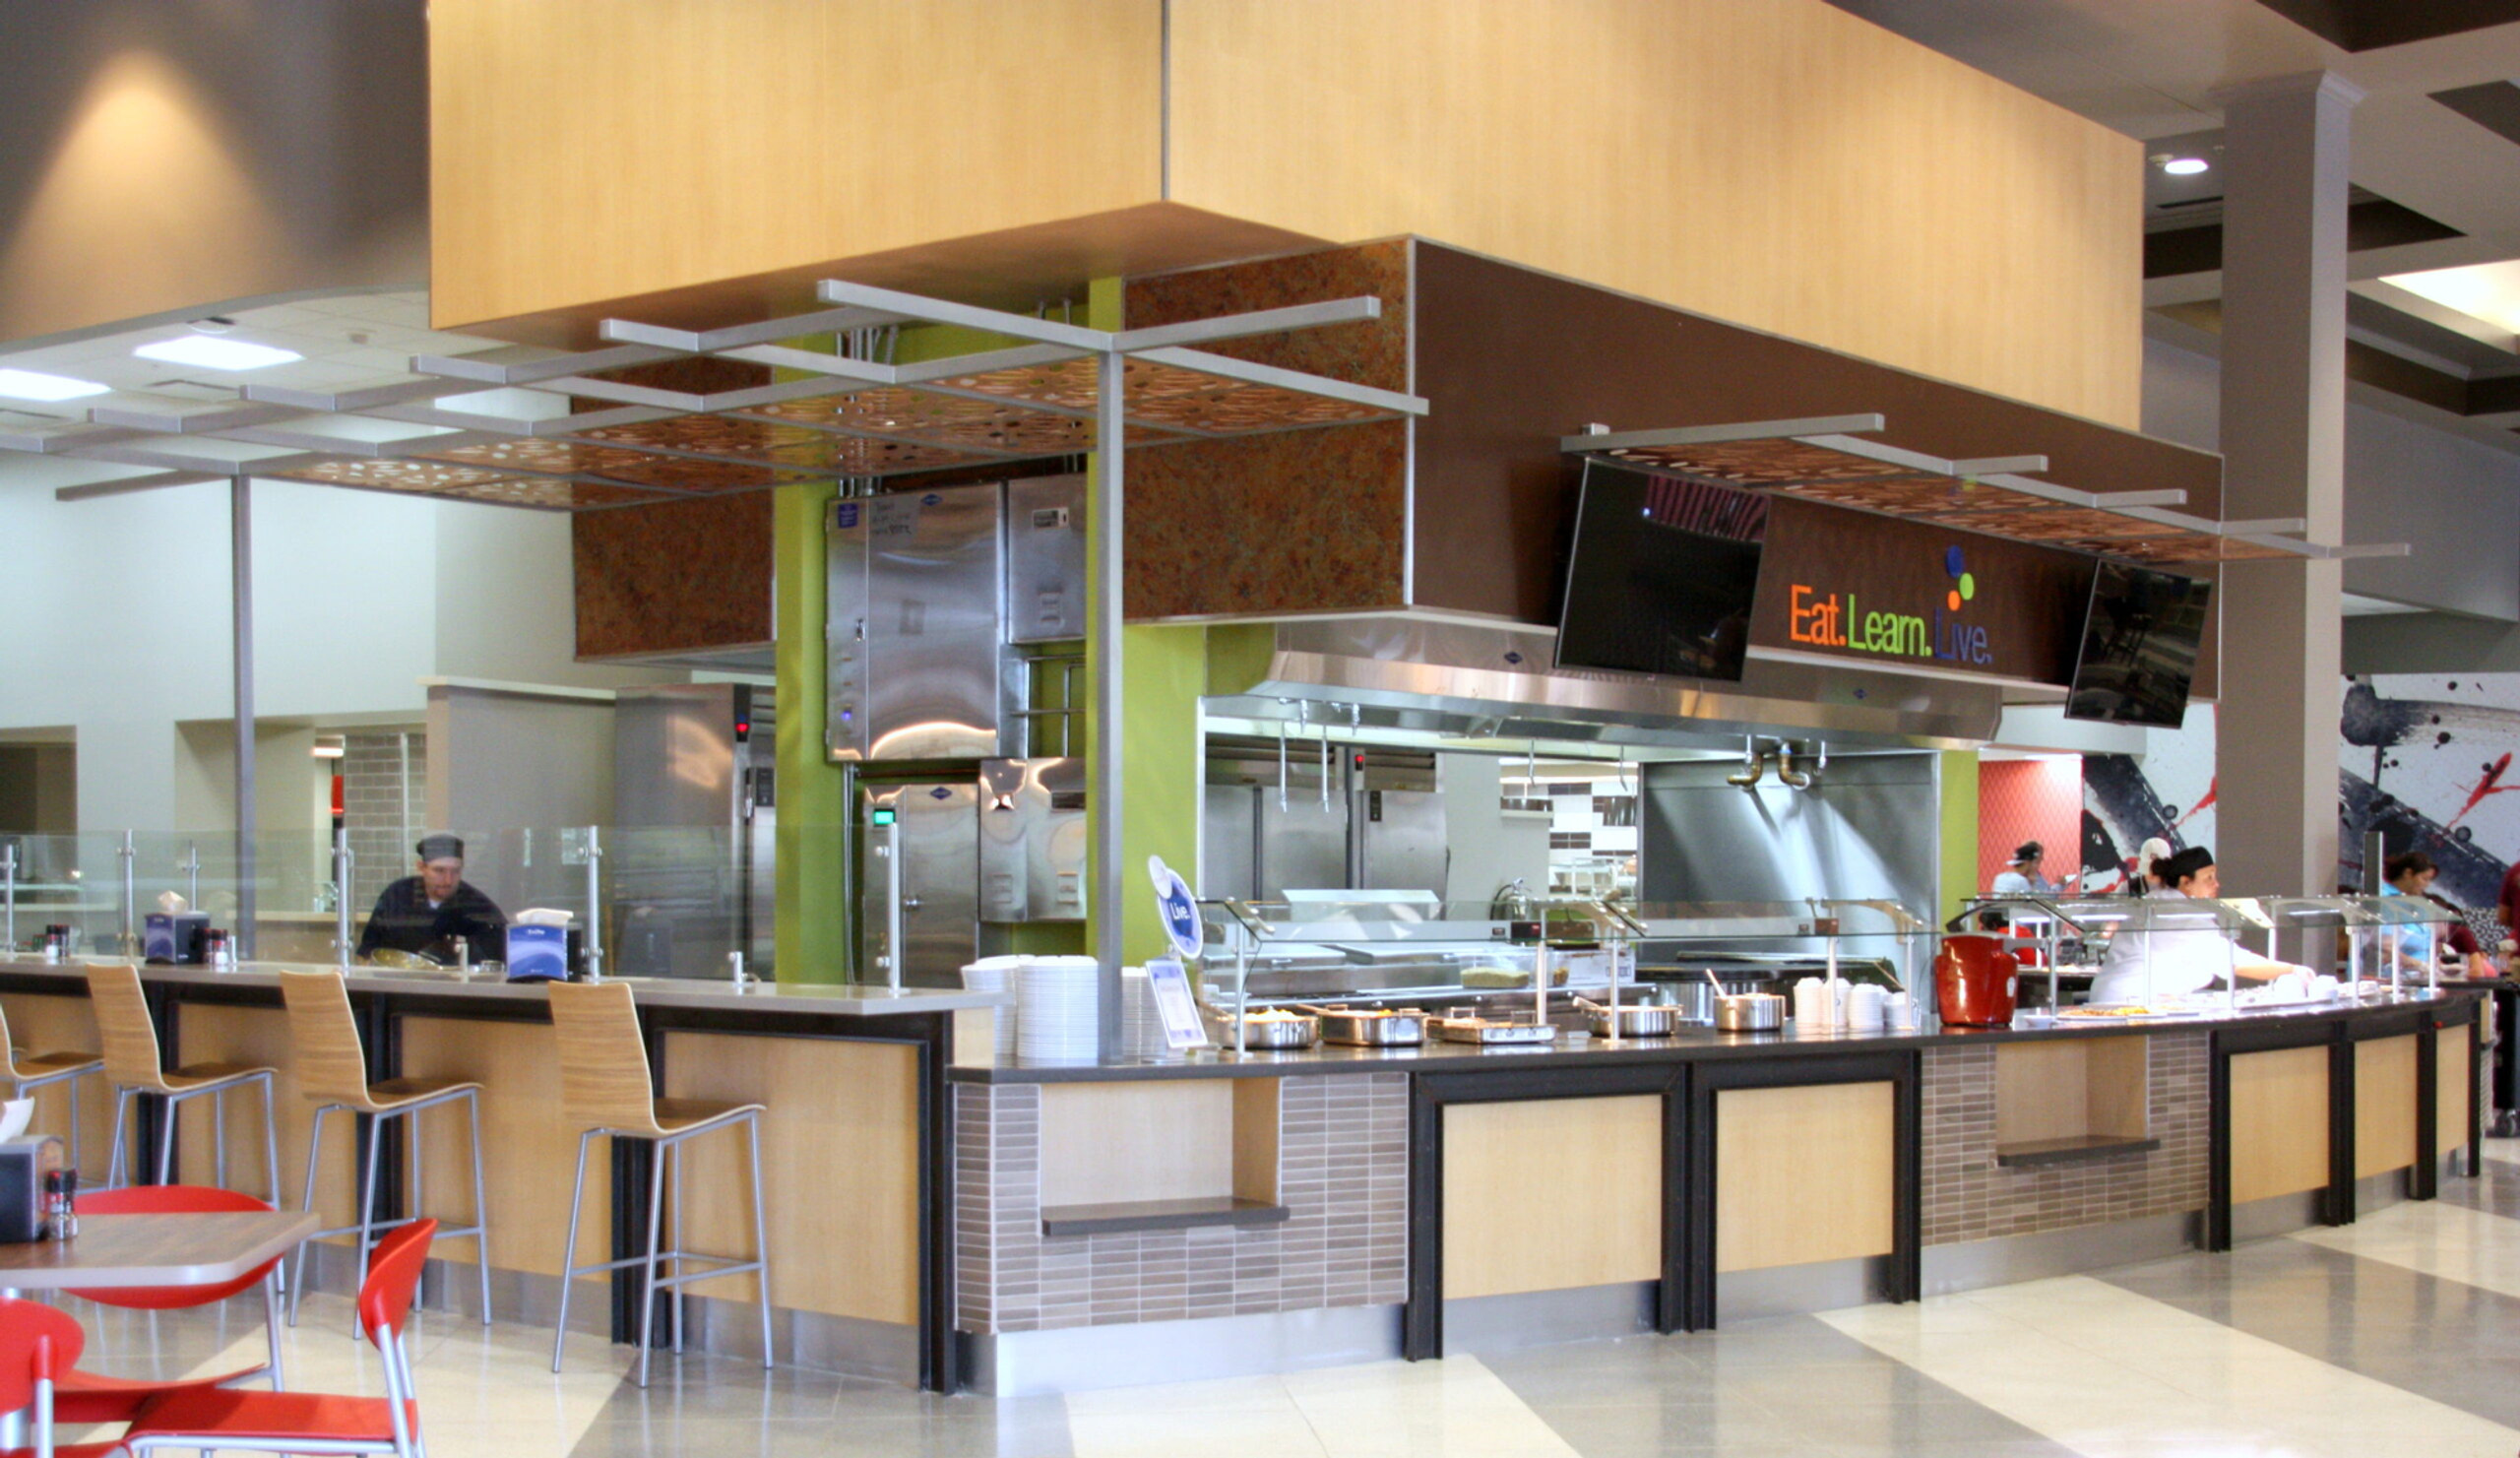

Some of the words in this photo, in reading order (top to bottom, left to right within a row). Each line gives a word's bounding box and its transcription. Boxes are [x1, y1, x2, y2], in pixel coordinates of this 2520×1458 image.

[1791, 584, 1847, 646] Eat.
[1848, 593, 1932, 657] Learn.
[1934, 606, 1992, 665] Live.
